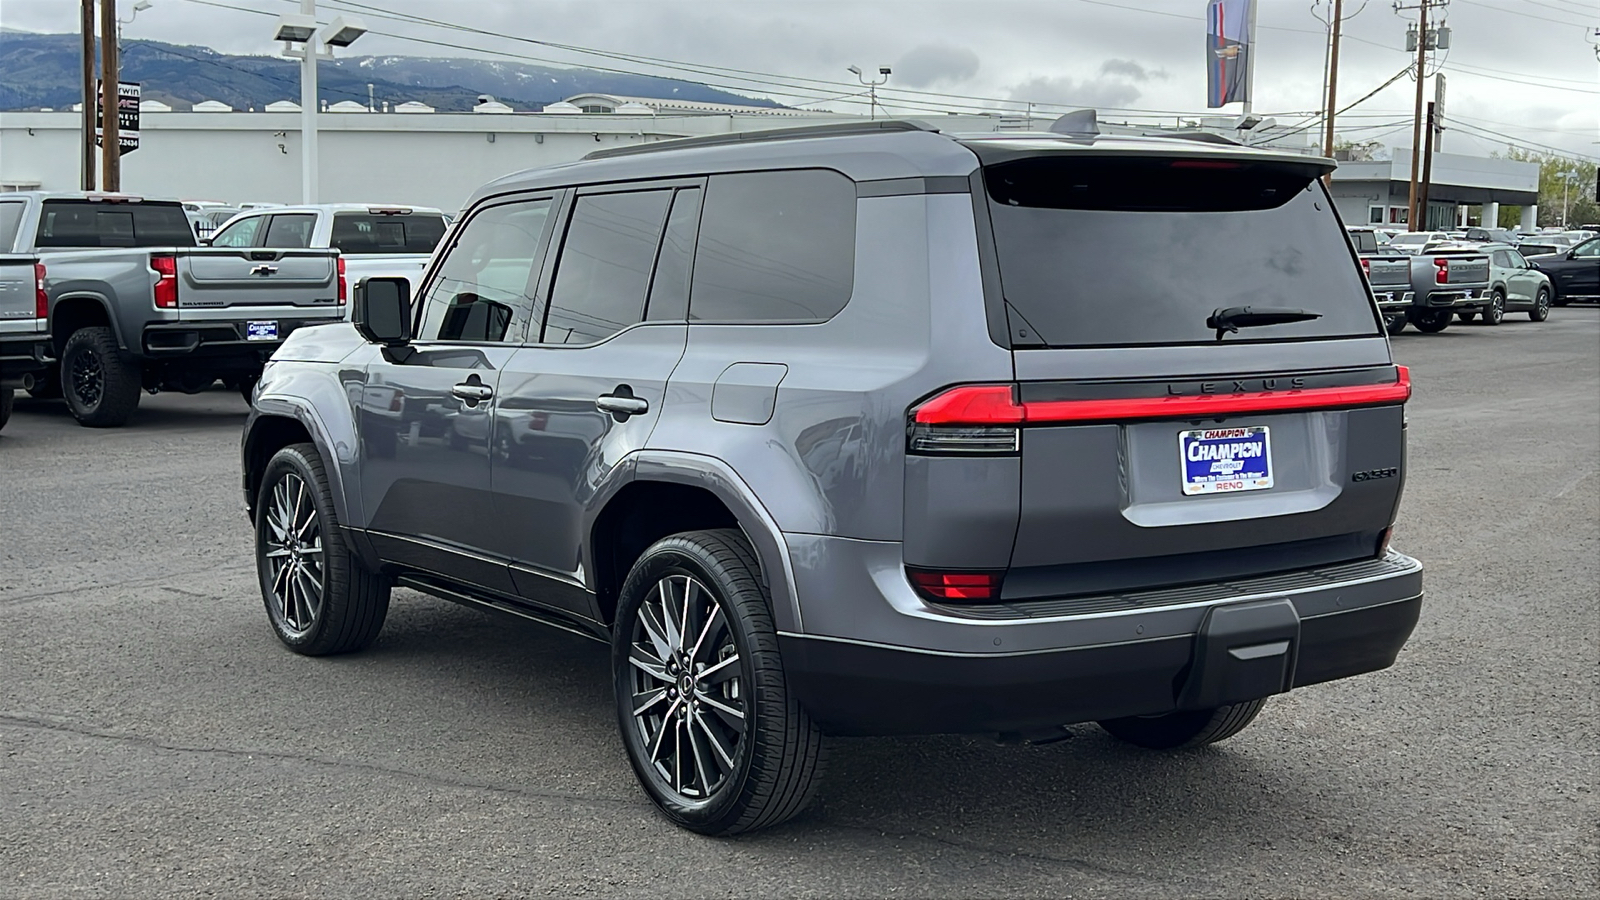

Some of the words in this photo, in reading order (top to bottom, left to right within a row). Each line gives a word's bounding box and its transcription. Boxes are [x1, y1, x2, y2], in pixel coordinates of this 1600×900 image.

[1167, 377, 1305, 396] LEXUS
[1204, 429, 1246, 439] CHAMPION
[1187, 441, 1263, 462] CHAMPION
[1212, 462, 1242, 470] CHEVROLET
[1216, 481, 1244, 491] RENO
